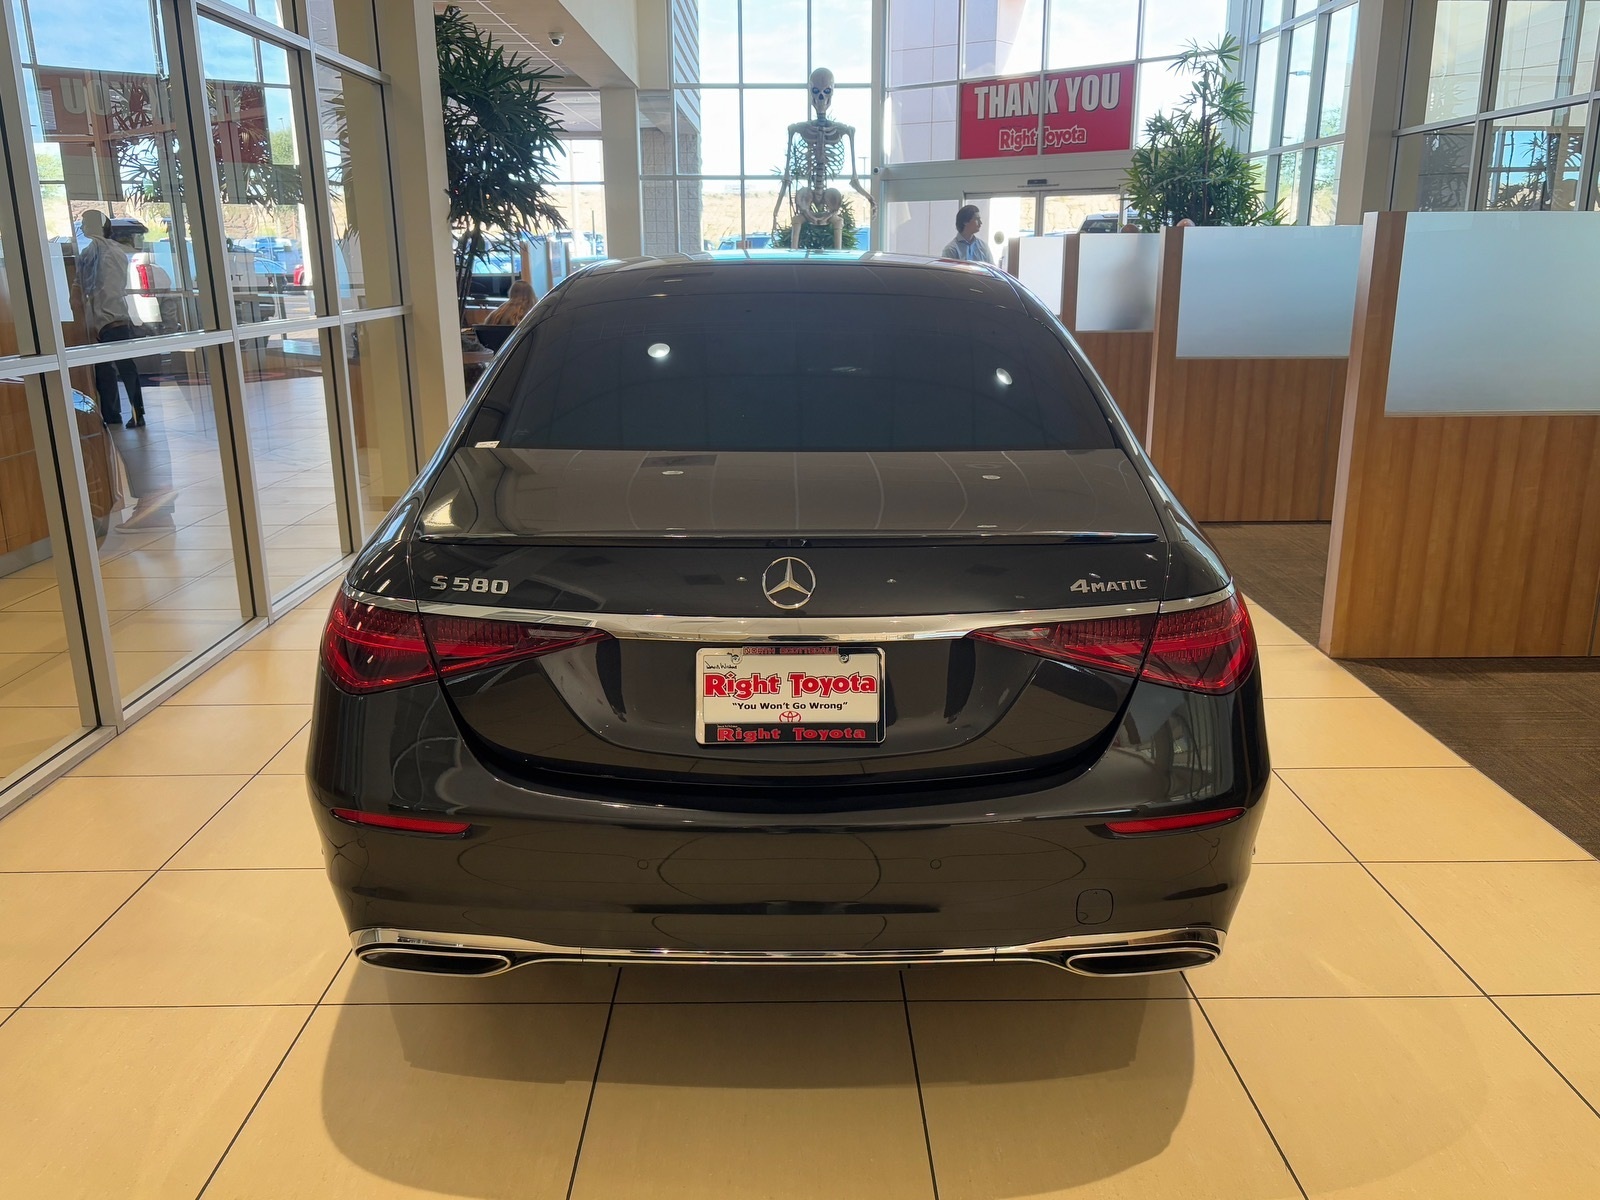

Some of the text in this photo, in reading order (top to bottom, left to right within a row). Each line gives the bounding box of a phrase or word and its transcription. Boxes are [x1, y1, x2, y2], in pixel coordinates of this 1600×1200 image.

[974, 72, 1121, 120] THANK YOU
[999, 124, 1087, 152] Right Toyota
[430, 575, 509, 594] S 580
[1070, 579, 1147, 593] 4MATIC
[704, 671, 877, 700] Right Toyota
[760, 702, 790, 710] Won't
[793, 702, 807, 710] Go
[717, 727, 866, 742] Right Toyota
